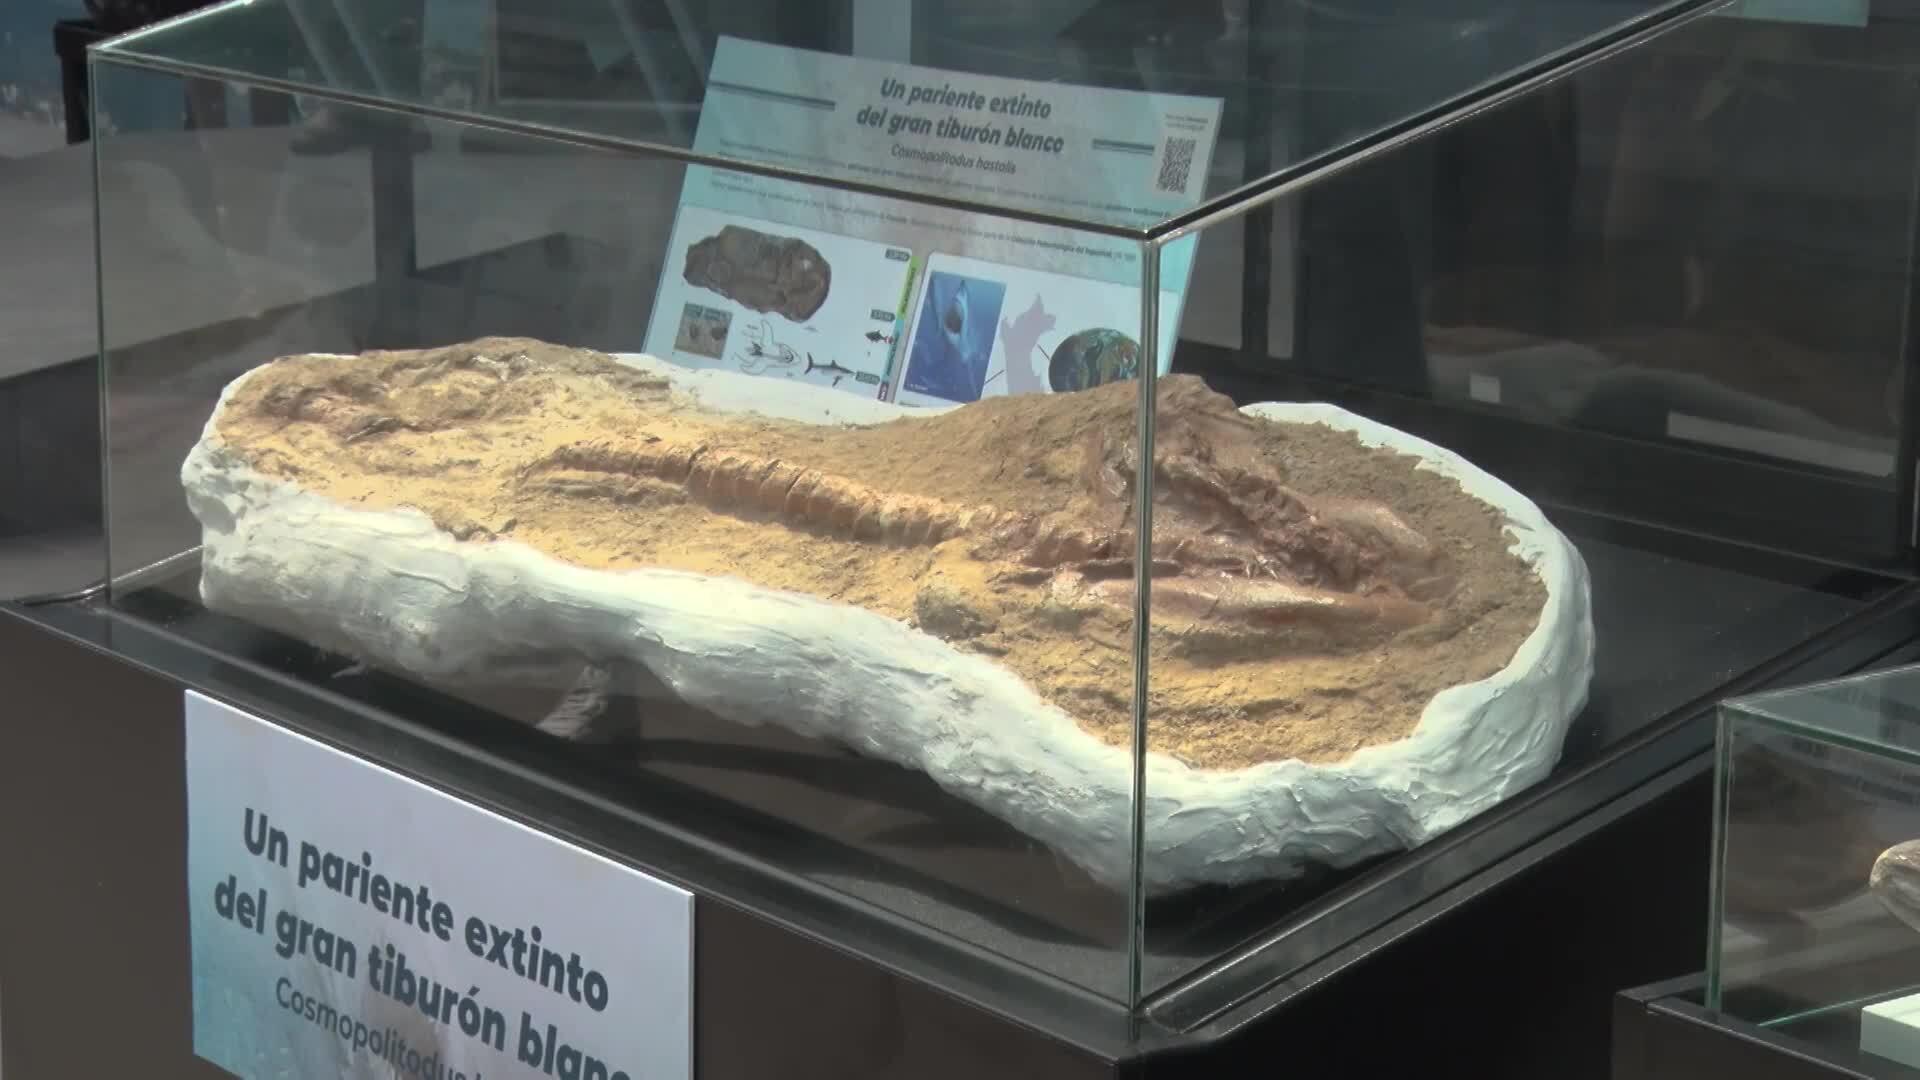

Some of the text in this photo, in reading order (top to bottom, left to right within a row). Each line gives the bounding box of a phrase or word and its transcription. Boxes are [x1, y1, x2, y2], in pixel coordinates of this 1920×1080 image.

[857, 106, 1064, 152] del gran tiburón blanco
[881, 79, 1051, 119] Un pariente extinto
[215, 874, 267, 935] del
[275, 909, 357, 979] gran
[367, 943, 506, 1052] tiburón
[244, 807, 609, 1012] Un pariente extinto
